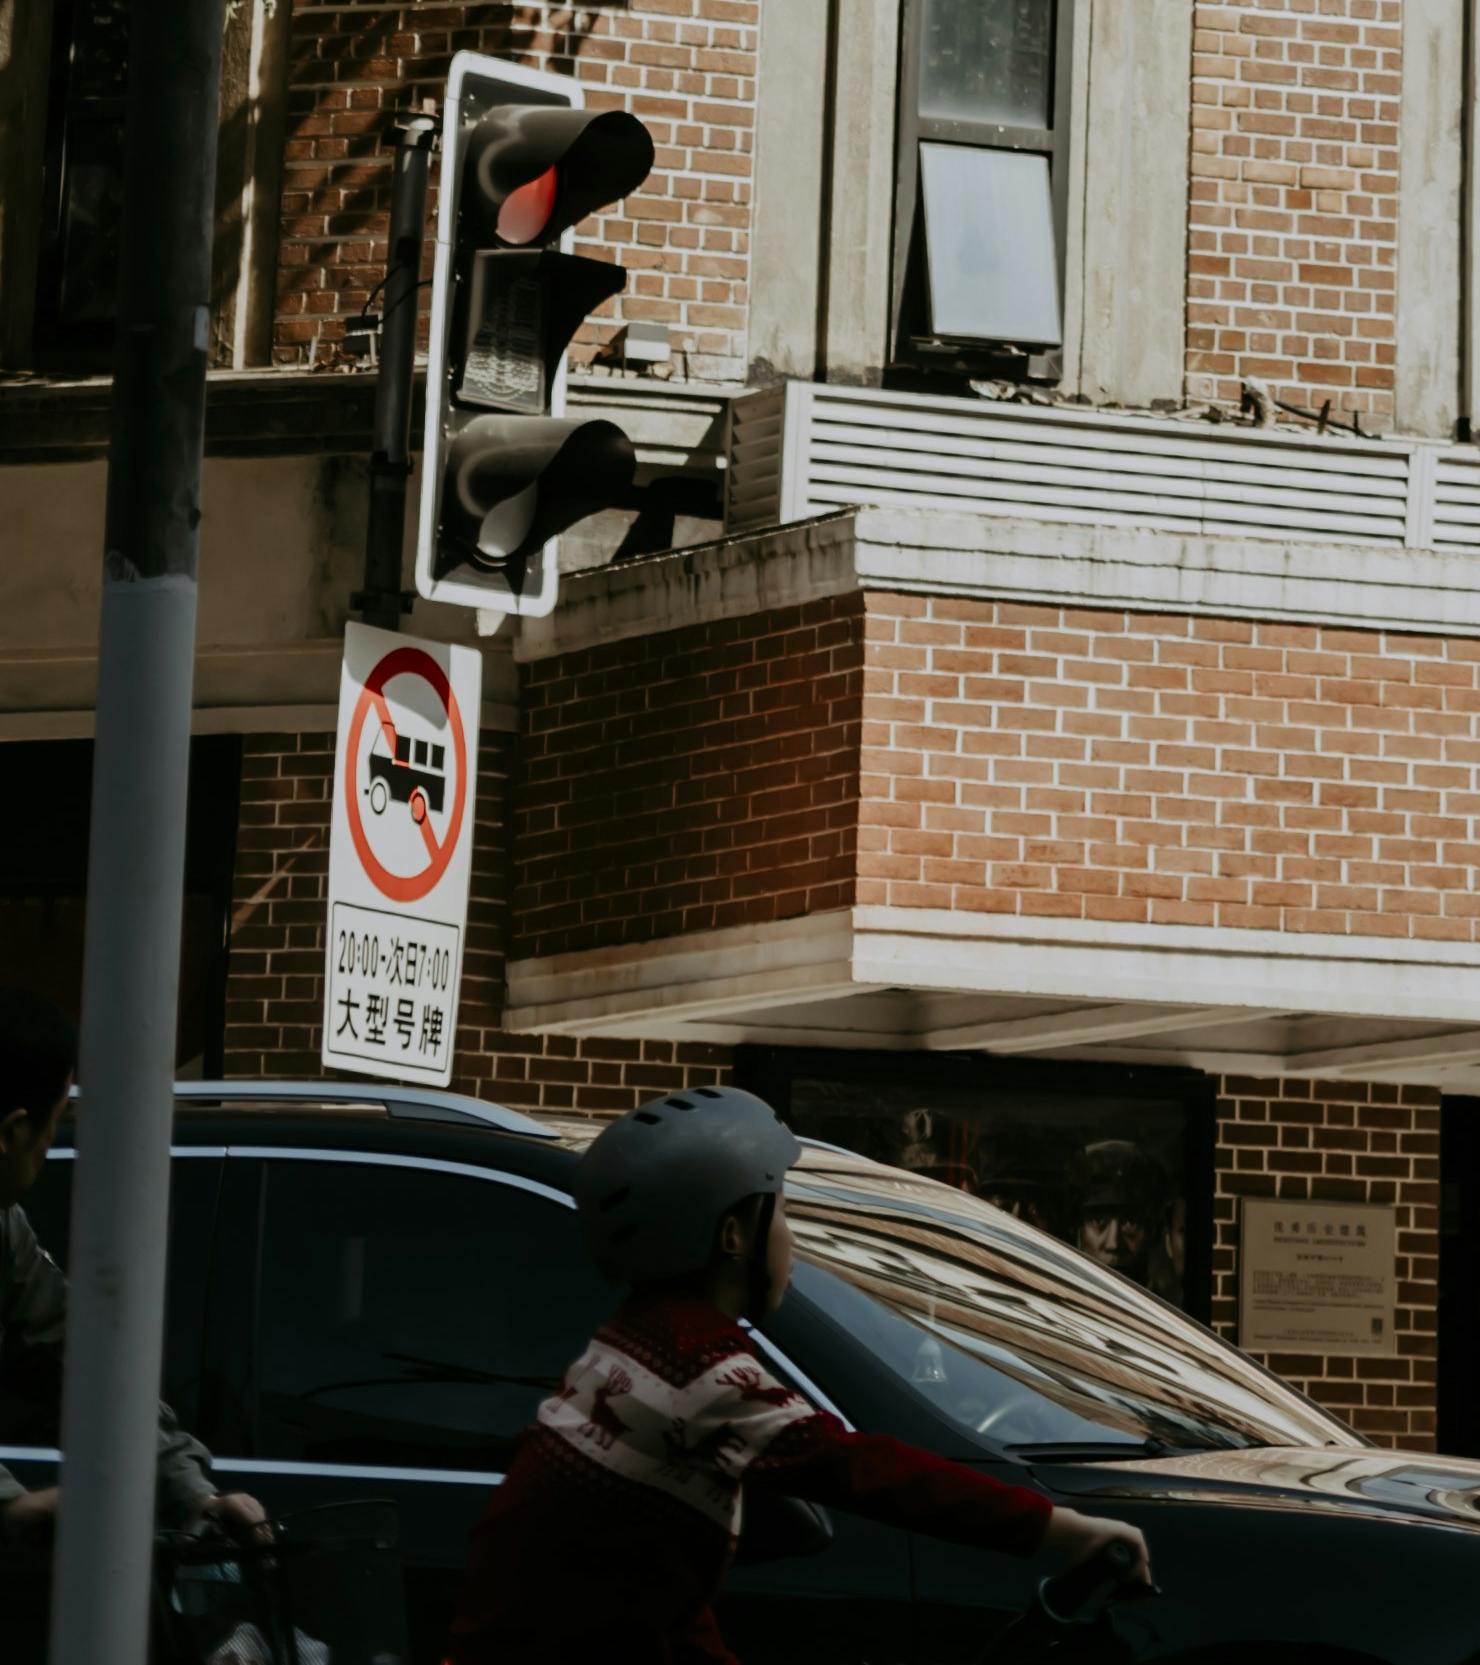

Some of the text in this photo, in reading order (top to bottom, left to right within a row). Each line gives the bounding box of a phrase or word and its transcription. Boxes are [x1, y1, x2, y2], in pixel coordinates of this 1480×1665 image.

[338, 929, 449, 992] 20:00-次日7:00
[336, 988, 444, 1059] 大型号牌
